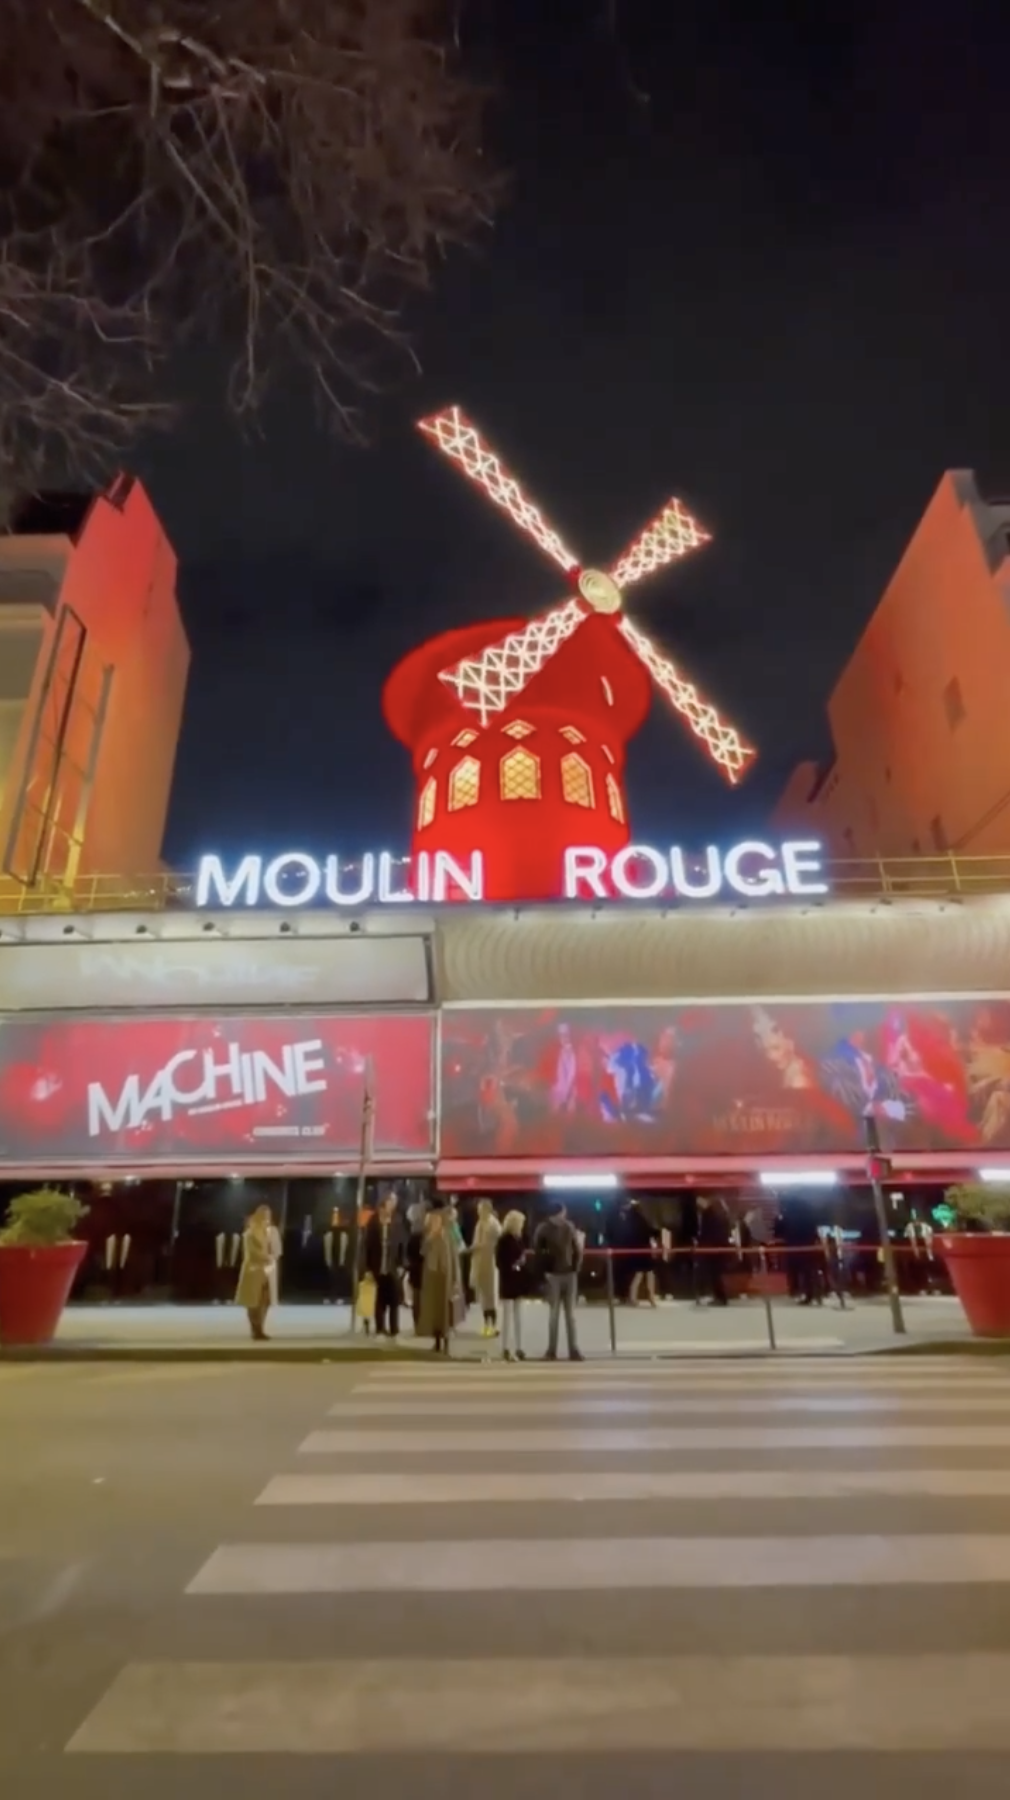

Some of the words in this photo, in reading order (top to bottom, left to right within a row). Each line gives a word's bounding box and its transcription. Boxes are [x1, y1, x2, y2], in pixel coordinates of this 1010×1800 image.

[196, 850, 484, 907] MOULIN
[564, 840, 829, 899] ROUGE
[87, 1039, 328, 1137] MACHINE
